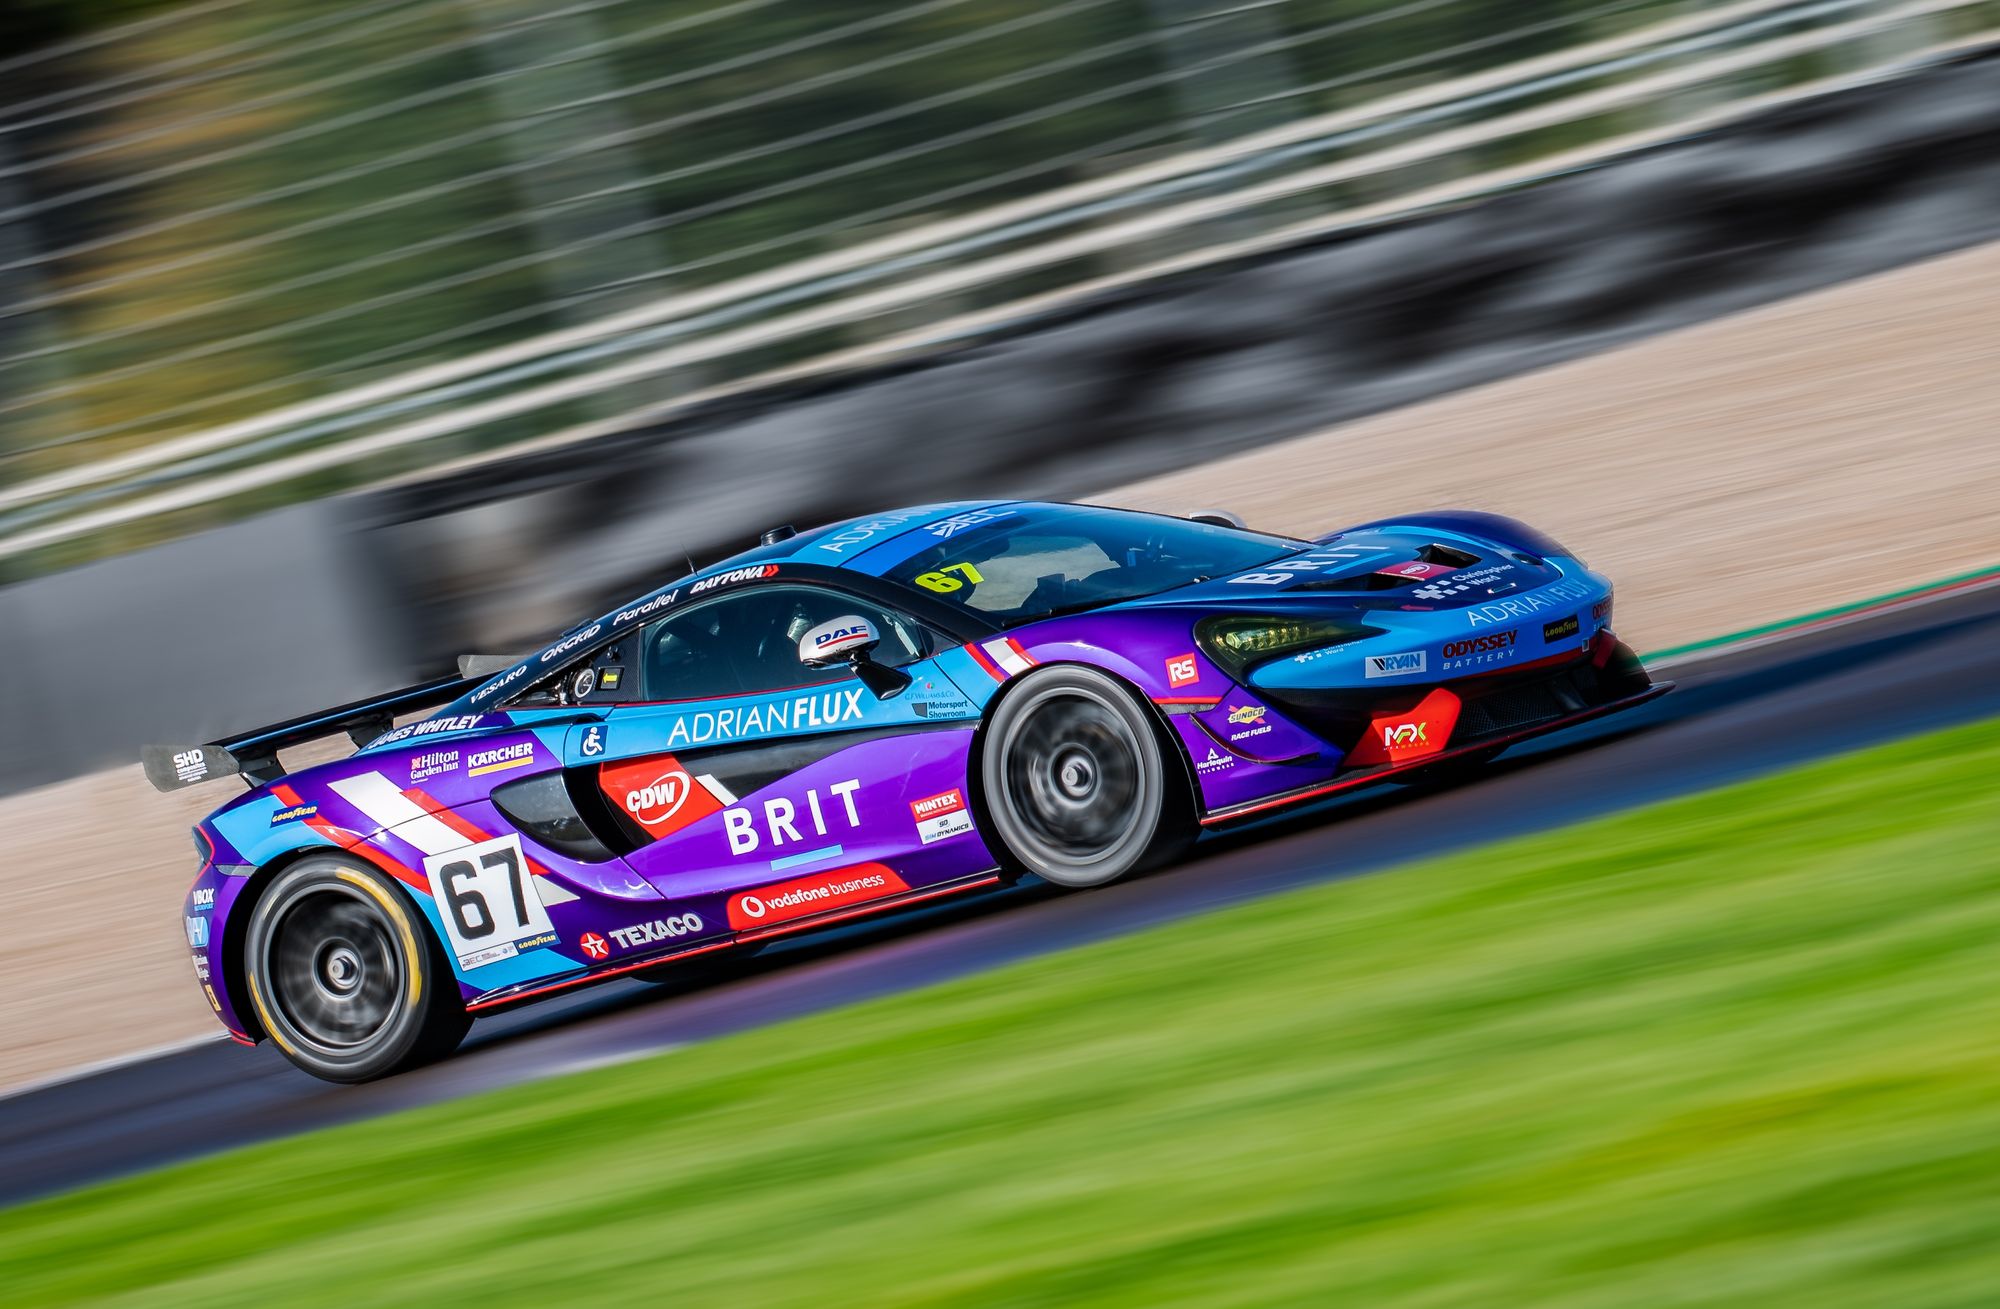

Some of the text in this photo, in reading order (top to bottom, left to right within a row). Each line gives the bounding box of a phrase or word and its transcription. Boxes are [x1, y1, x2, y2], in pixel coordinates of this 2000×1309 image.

[1227, 543, 1391, 585] BRIT
[690, 565, 766, 594] DAYTONA
[914, 562, 985, 593] 67
[613, 590, 679, 626] Parallel
[815, 625, 867, 646] DAF
[1545, 621, 1578, 638] GOODYEAR
[540, 624, 601, 663] ORCKID
[1443, 629, 1518, 659] ODYSSEY
[1386, 653, 1421, 670] RYAN
[1443, 649, 1514, 670] BATTERY
[1169, 659, 1195, 682] RS
[470, 665, 527, 704] VESARO
[928, 699, 968, 710] Motorsport
[928, 710, 966, 719] Showroom
[1229, 707, 1265, 723] SUNOCO
[413, 715, 484, 736] WHITLEY
[1231, 725, 1272, 741] RACE FUELS
[173, 749, 204, 769] SHD
[421, 750, 459, 768] Hilton
[467, 742, 534, 767] KÄRCHER
[1197, 755, 1233, 769] Harlequin
[410, 762, 459, 780] Garden Inn
[626, 782, 676, 812] CDW
[915, 793, 958, 814] MINTEX
[271, 805, 318, 823] GOODYEAR
[723, 778, 861, 856] BRIT
[937, 823, 969, 838] DYNAMICS
[193, 888, 215, 905] VBOX
[439, 846, 531, 941] 67
[765, 873, 885, 911] vodafone business
[518, 934, 556, 950] GOODYEAR
[608, 913, 703, 950] TEXACO
